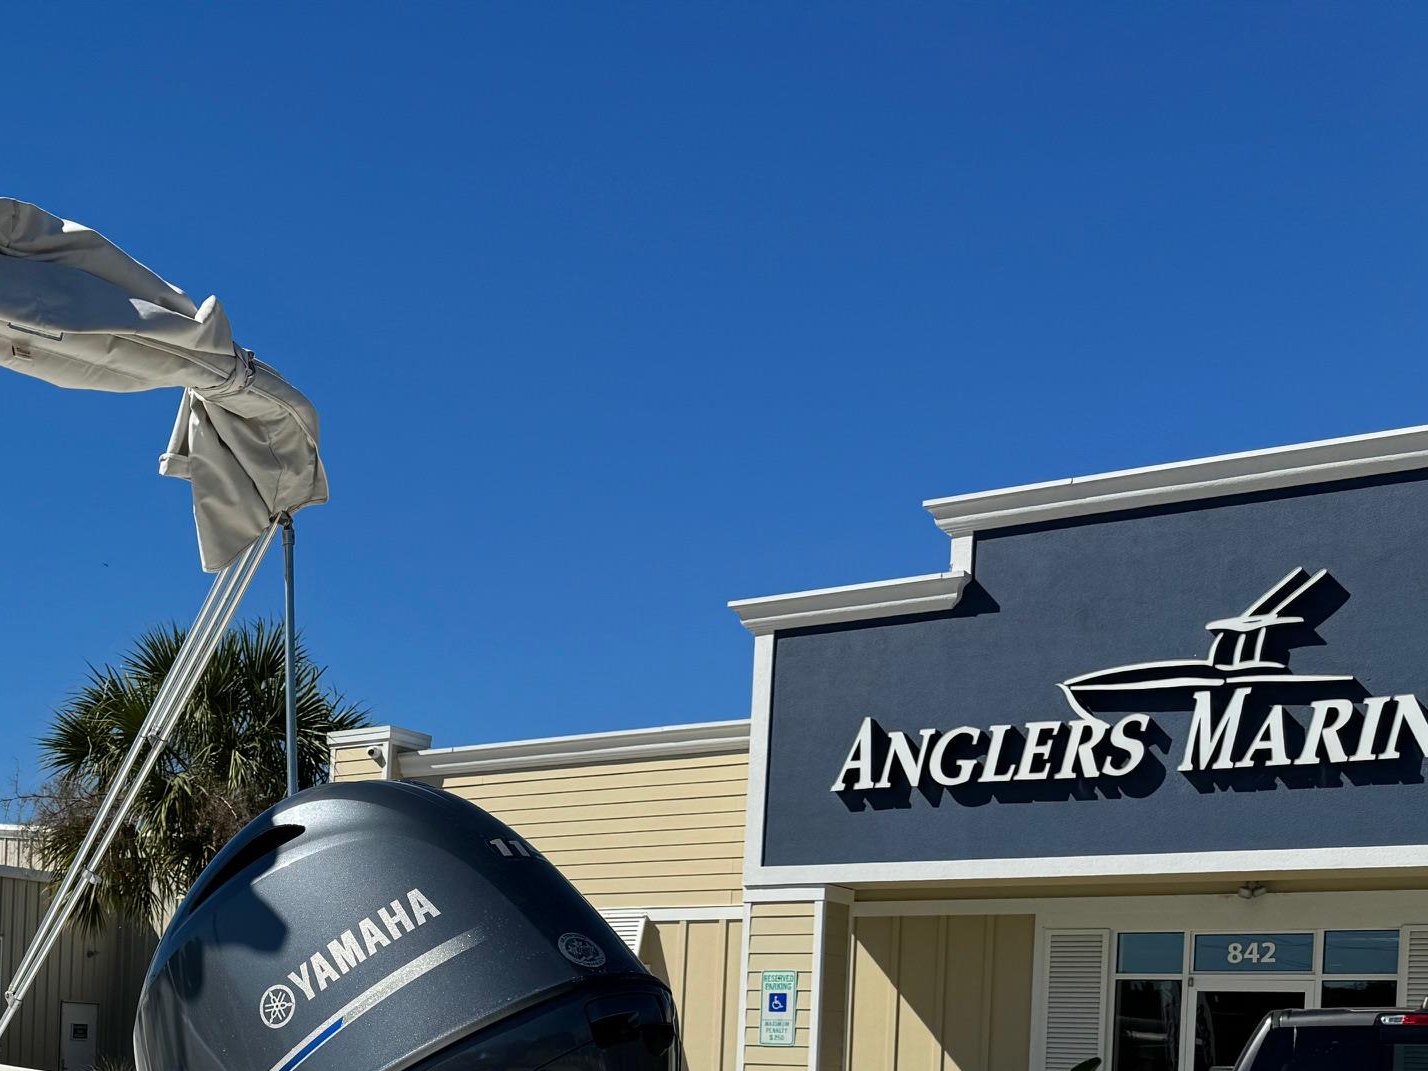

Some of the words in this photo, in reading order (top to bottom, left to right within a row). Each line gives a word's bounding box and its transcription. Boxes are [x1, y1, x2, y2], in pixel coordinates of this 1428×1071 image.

[830, 713, 1150, 792] ANGLERS
[1177, 686, 1428, 771] MARIN
[287, 888, 442, 1001] YAMAHA
[1227, 942, 1276, 964] 842
[763, 974, 793, 983] RESERVED
[764, 982, 792, 991] PARKING
